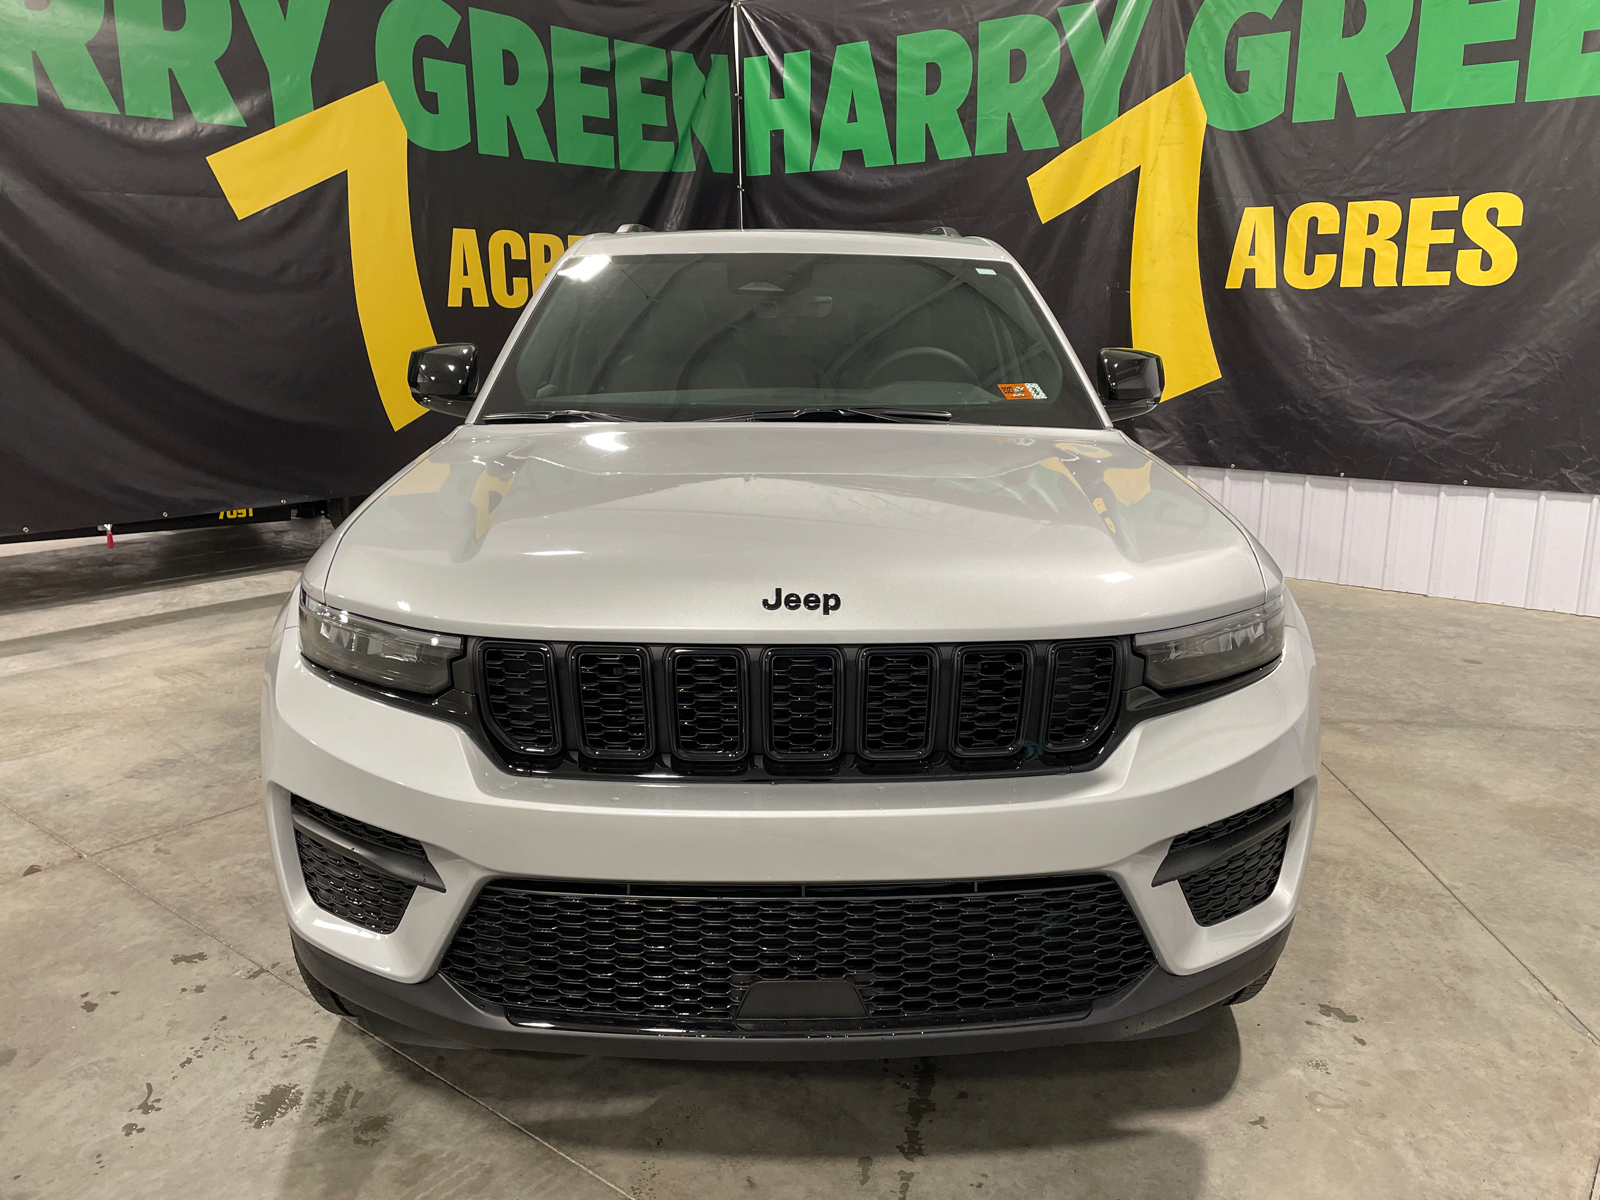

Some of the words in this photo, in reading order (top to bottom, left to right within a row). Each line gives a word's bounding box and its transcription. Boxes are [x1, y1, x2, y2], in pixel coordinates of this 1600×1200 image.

[375, 0, 734, 174] GREEN
[743, 0, 1154, 177] HARRY
[206, 81, 436, 431] 7
[447, 227, 586, 309] ACR
[1027, 73, 1222, 402] 7
[1226, 191, 1524, 289] ACRES
[762, 587, 841, 615] Jeep
